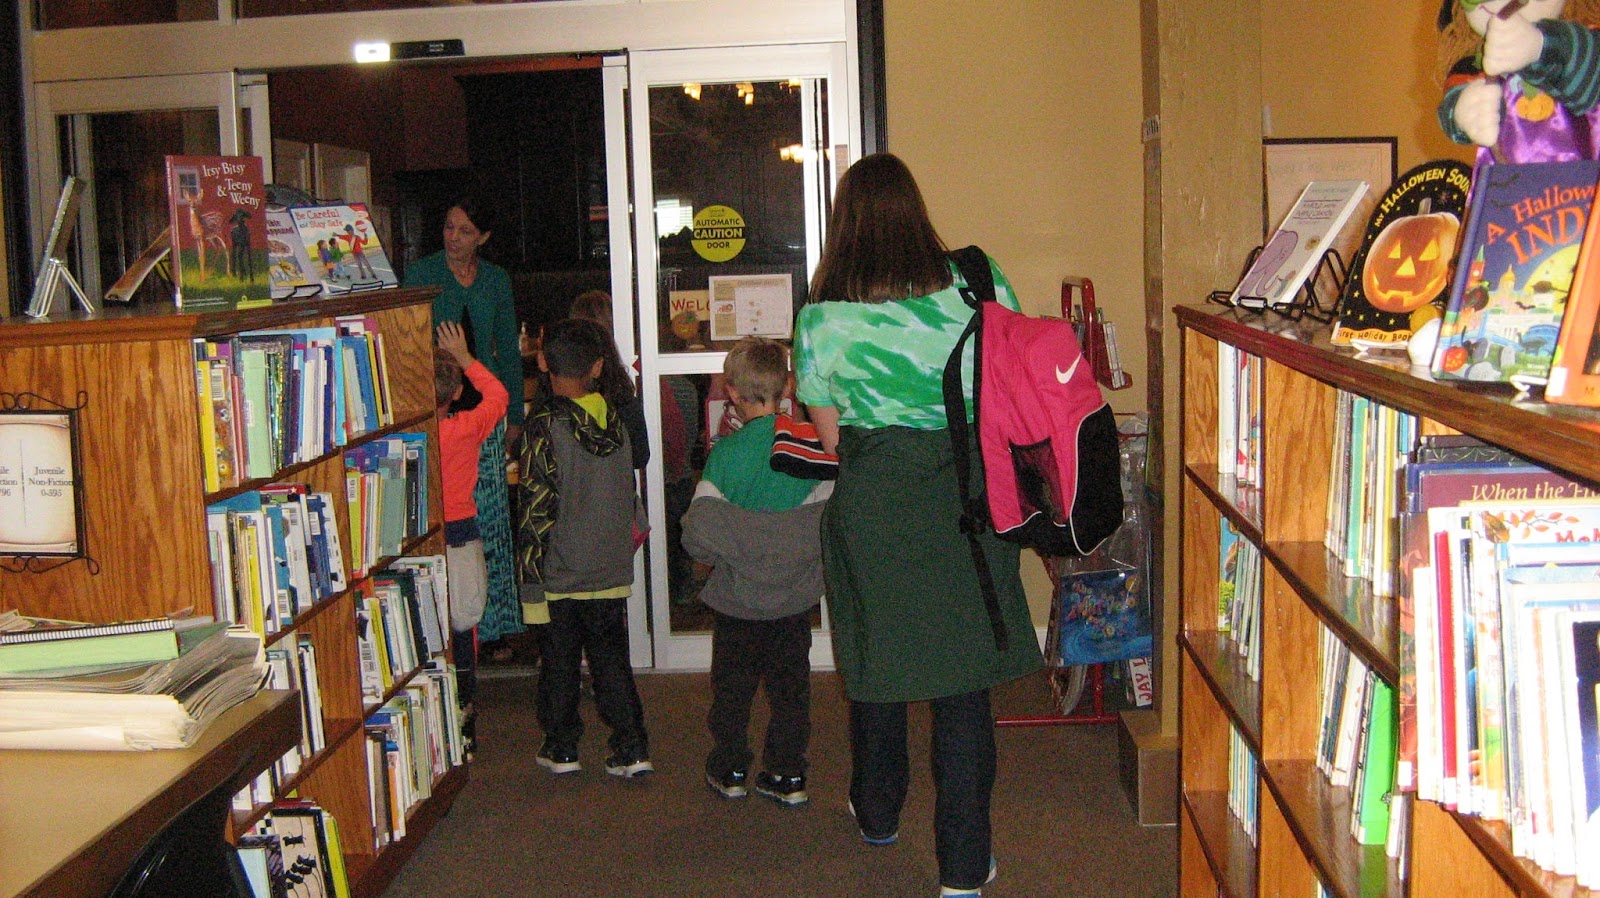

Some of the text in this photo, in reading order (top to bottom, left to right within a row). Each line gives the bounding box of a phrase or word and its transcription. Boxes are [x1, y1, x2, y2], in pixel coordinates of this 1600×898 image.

[202, 162, 246, 178] Itsy Bitsy
[225, 178, 253, 195] Teeny
[1381, 168, 1446, 214] HALLOWEEN
[1446, 168, 1471, 196] SOUN
[217, 185, 261, 209] & Weeny
[306, 208, 341, 220] Careful
[695, 218, 740, 227] AUTOMATIC
[1487, 184, 1596, 245] A Hallow
[693, 228, 743, 239] CAUTION
[1505, 205, 1587, 266] IND
[33, 466, 65, 476] Juvenile
[1471, 483, 1527, 501] When
[1535, 482, 1564, 499] the
